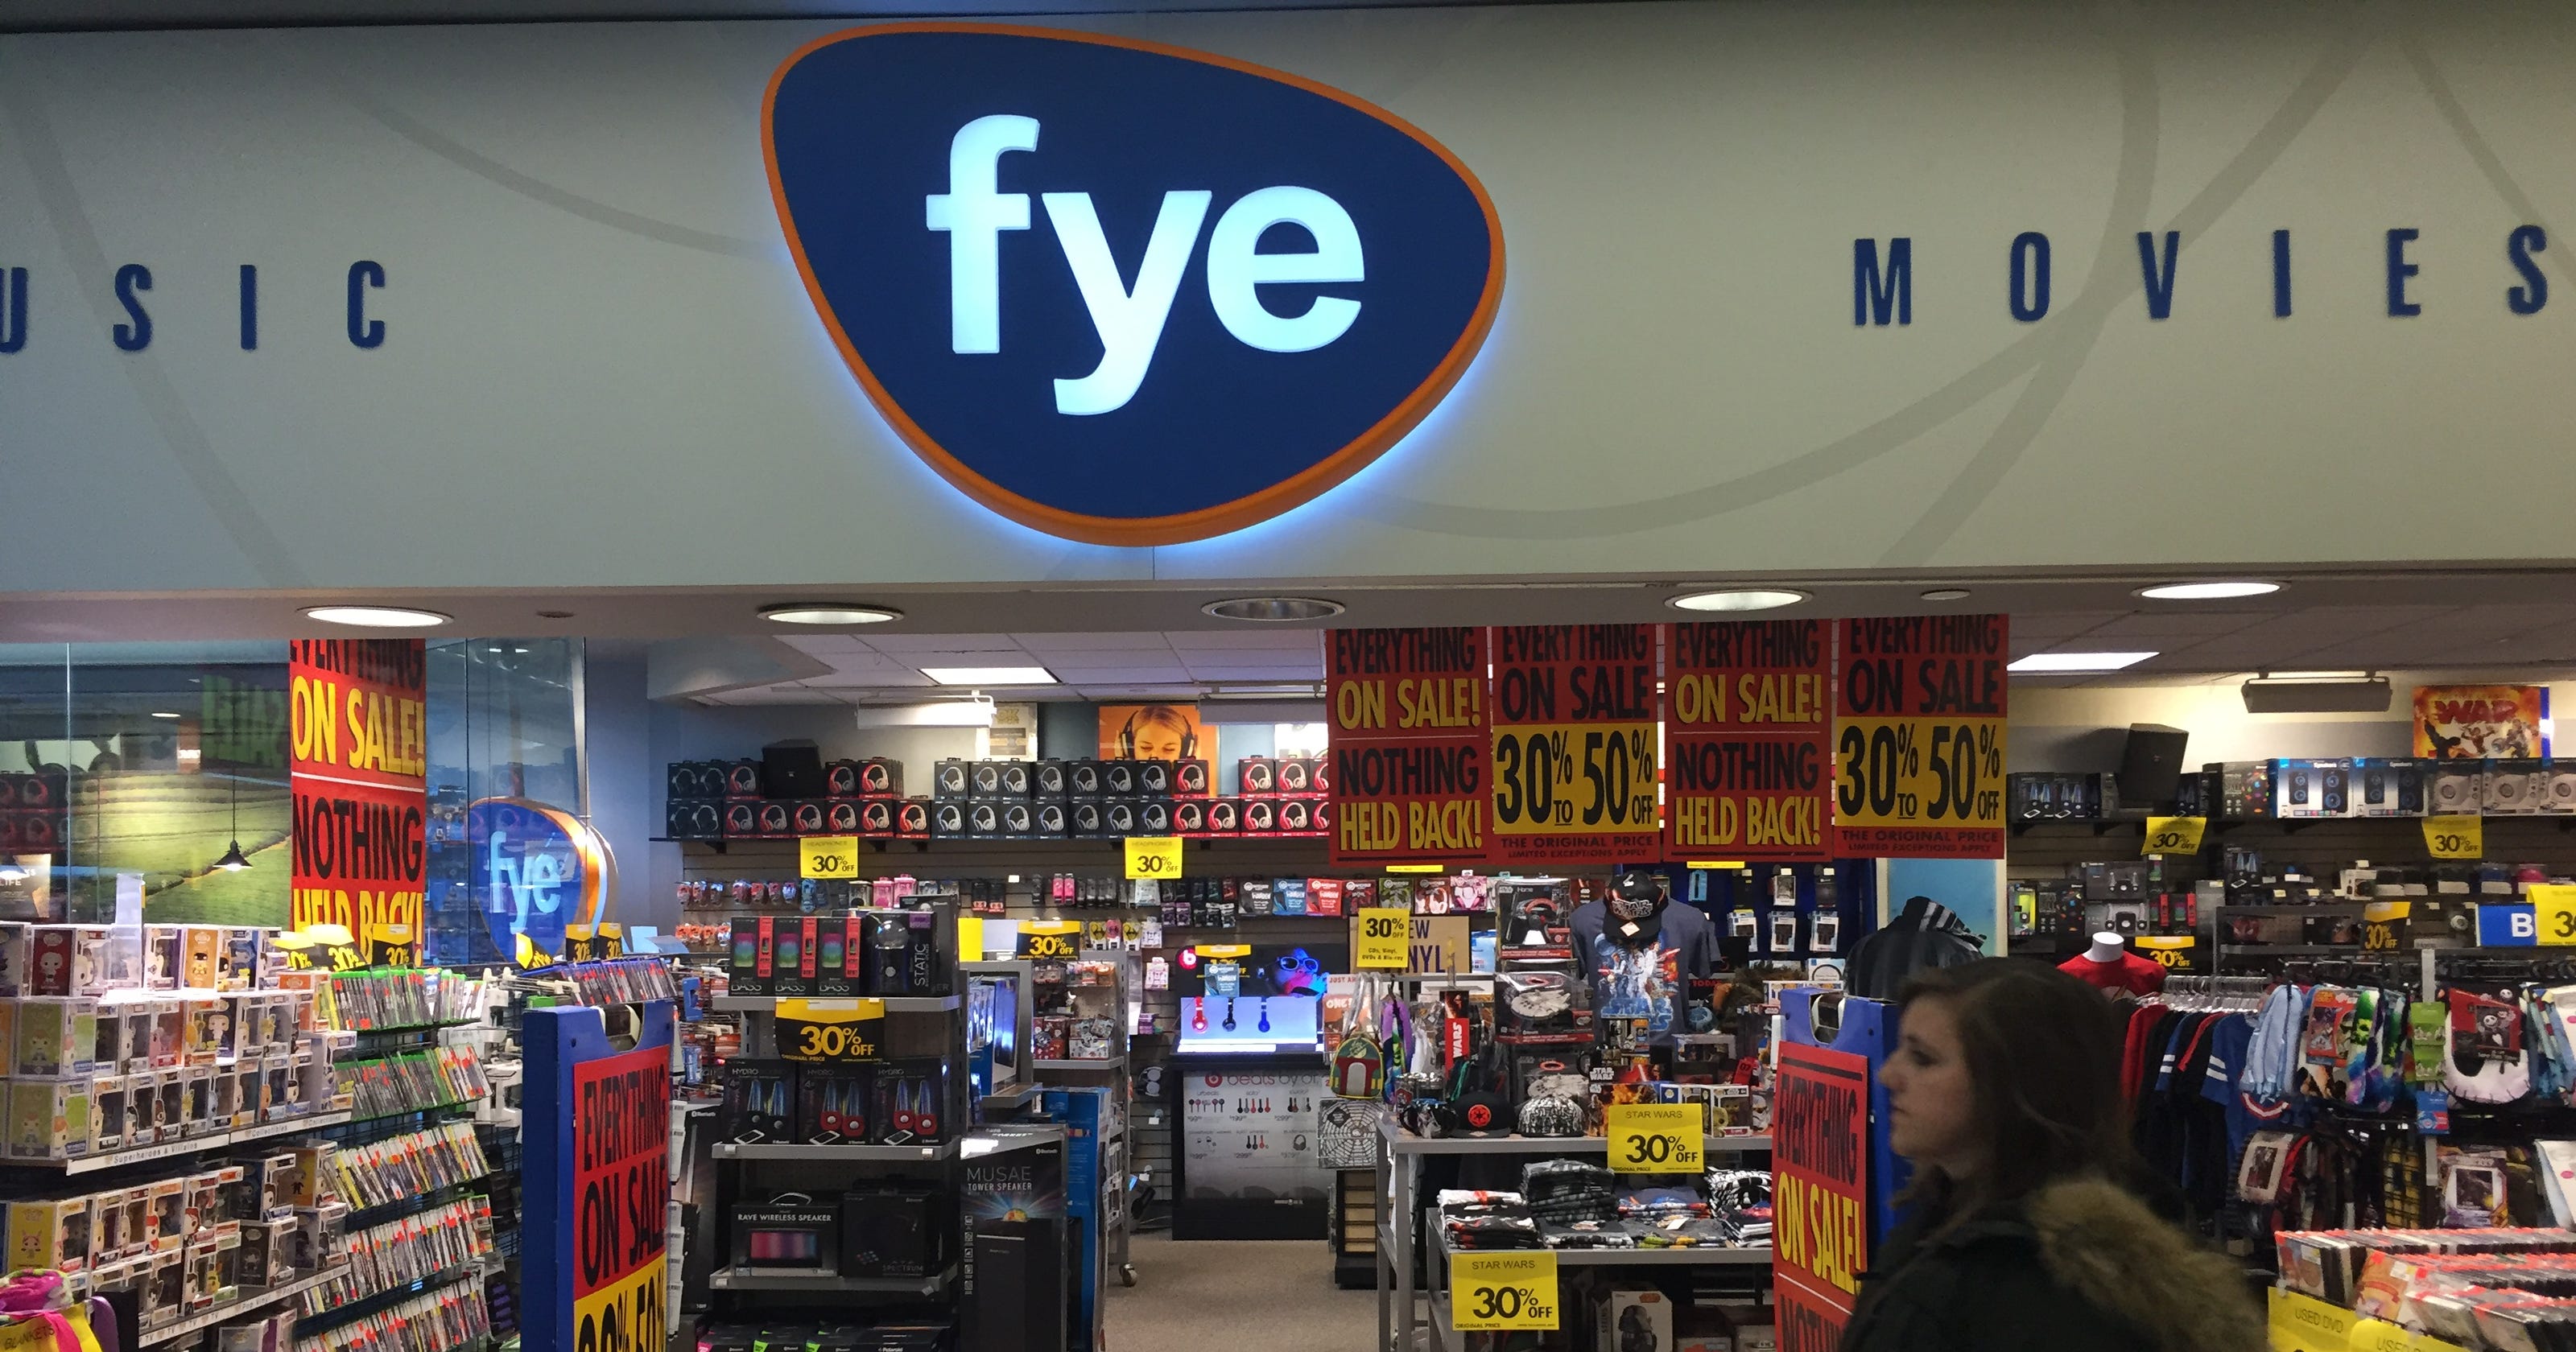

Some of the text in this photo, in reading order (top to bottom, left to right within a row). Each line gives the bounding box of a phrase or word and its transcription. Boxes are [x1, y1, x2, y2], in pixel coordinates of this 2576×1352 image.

[925, 113, 1365, 416] fye
[1854, 224, 2549, 328] MOVIES
[1502, 624, 1648, 663] EVERYTHING
[1675, 621, 1819, 669] EVERYTHING
[1852, 615, 2000, 655] EVERYTHING
[1335, 629, 1476, 674] EVERYTHING
[1501, 666, 1649, 722] ON SALE
[1674, 673, 1823, 723] ON SALE!
[1846, 658, 1999, 714] ON SALE
[1336, 678, 1481, 729] ON SALE!
[291, 675, 337, 765] ON
[346, 688, 426, 777] SALE!
[1338, 745, 1480, 797] NOTHING
[1496, 729, 1653, 826] 30% TO 50% OFF
[1675, 742, 1819, 791] NOTHING
[1838, 723, 2000, 821] 30% TO 50% OFF
[1340, 800, 1483, 851] HELD BACK!
[1675, 796, 1822, 846] HELD BACK!
[1842, 830, 1998, 843] THE ORIGINAL PRICE
[293, 793, 423, 883] NOTHING
[1501, 835, 1653, 848] THE ORIGINAL PRICE
[1508, 848, 1647, 859] LIMITED EXCEPTIONS APPLY
[1848, 843, 1889, 852] LIMITED
[1960, 843, 1992, 853] APPLY
[2152, 832, 2190, 848] 30%
[2434, 835, 2471, 852] 30%
[811, 855, 848, 872] 30%
[1137, 855, 1173, 872] 30%
[485, 831, 562, 934] fye
[1365, 917, 1405, 938] 30%
[1409, 920, 1430, 939] EW
[2364, 925, 2398, 950] 30% OFF
[2554, 910, 2576, 938] 3
[288, 950, 313, 971] 0%
[1029, 936, 1067, 955] 30%
[1397, 945, 1446, 974] NYL
[2149, 950, 2184, 967] 30%
[914, 943, 927, 987] STATIC
[799, 1025, 875, 1057] 30% OFF
[1452, 1022, 1463, 1058] WARS
[1228, 1071, 1275, 1086] beats
[1590, 1073, 1615, 1081] WARS
[1591, 1067, 1614, 1075] STAR
[583, 1063, 666, 1173] EVERYTHING
[1625, 1111, 1683, 1119] STAR WARS
[1777, 1074, 1859, 1187] EVERYTHING
[114, 1148, 161, 1164] Superheroes
[171, 1142, 198, 1154] Villains
[1625, 1134, 1699, 1164] 30% OFF
[967, 1166, 1031, 1181] MUSAE
[968, 1182, 1033, 1191] TOWER SPEAKER
[582, 1153, 667, 1288] ON SALE
[760, 1214, 796, 1222] WIRELESS
[1777, 1171, 1862, 1296] ON SALE!
[1472, 1259, 1536, 1270] STAR WARS
[1472, 1286, 1553, 1319] 30% OFF
[2294, 1308, 2344, 1333] USED DVD
